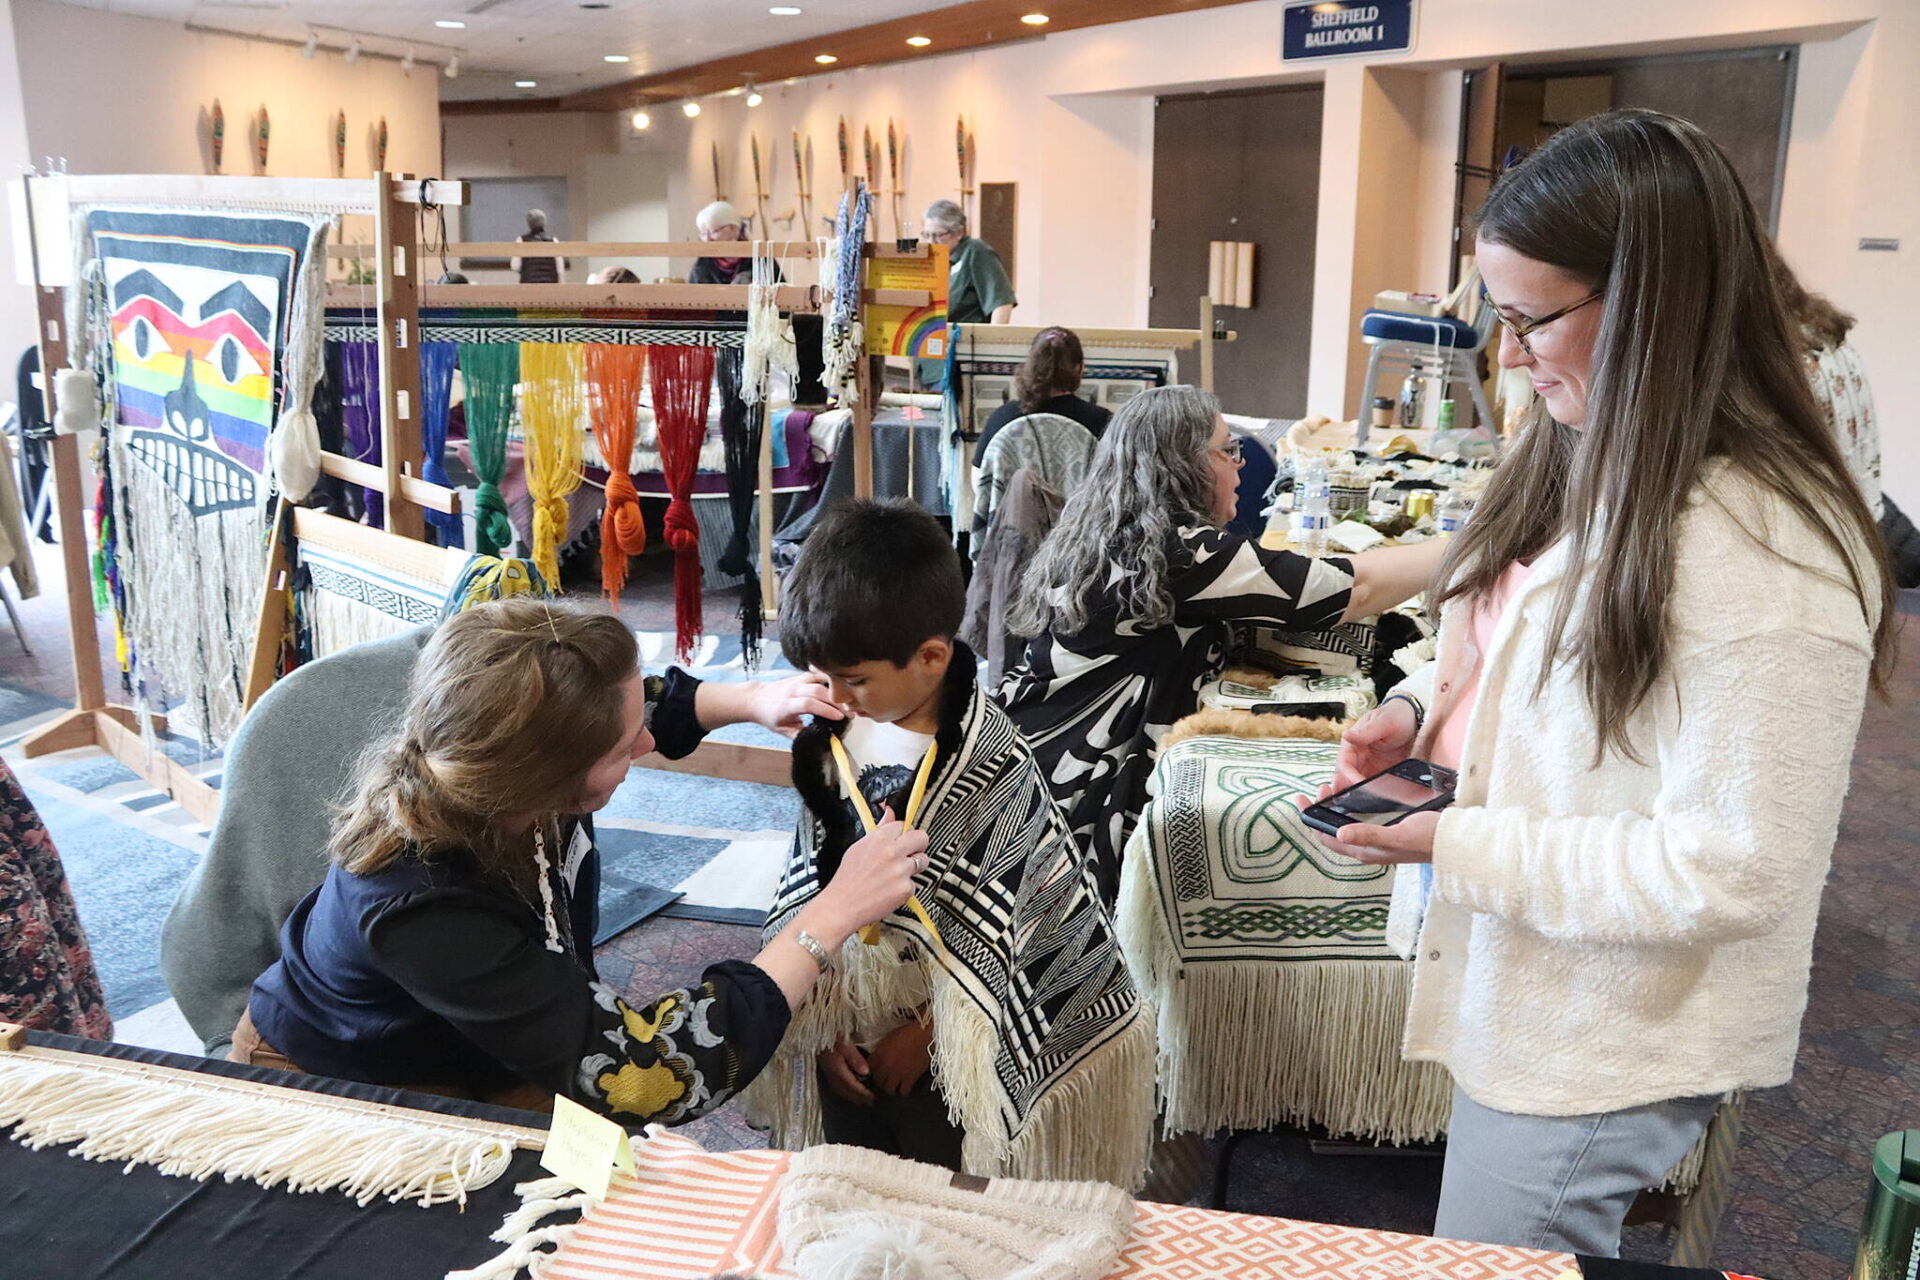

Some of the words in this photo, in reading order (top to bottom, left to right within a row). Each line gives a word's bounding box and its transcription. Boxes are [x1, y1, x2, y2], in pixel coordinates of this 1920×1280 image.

[1312, 6, 1379, 28] SHEFFIELD
[1305, 26, 1373, 48] BALLROOM
[1377, 25, 1384, 41] 1
